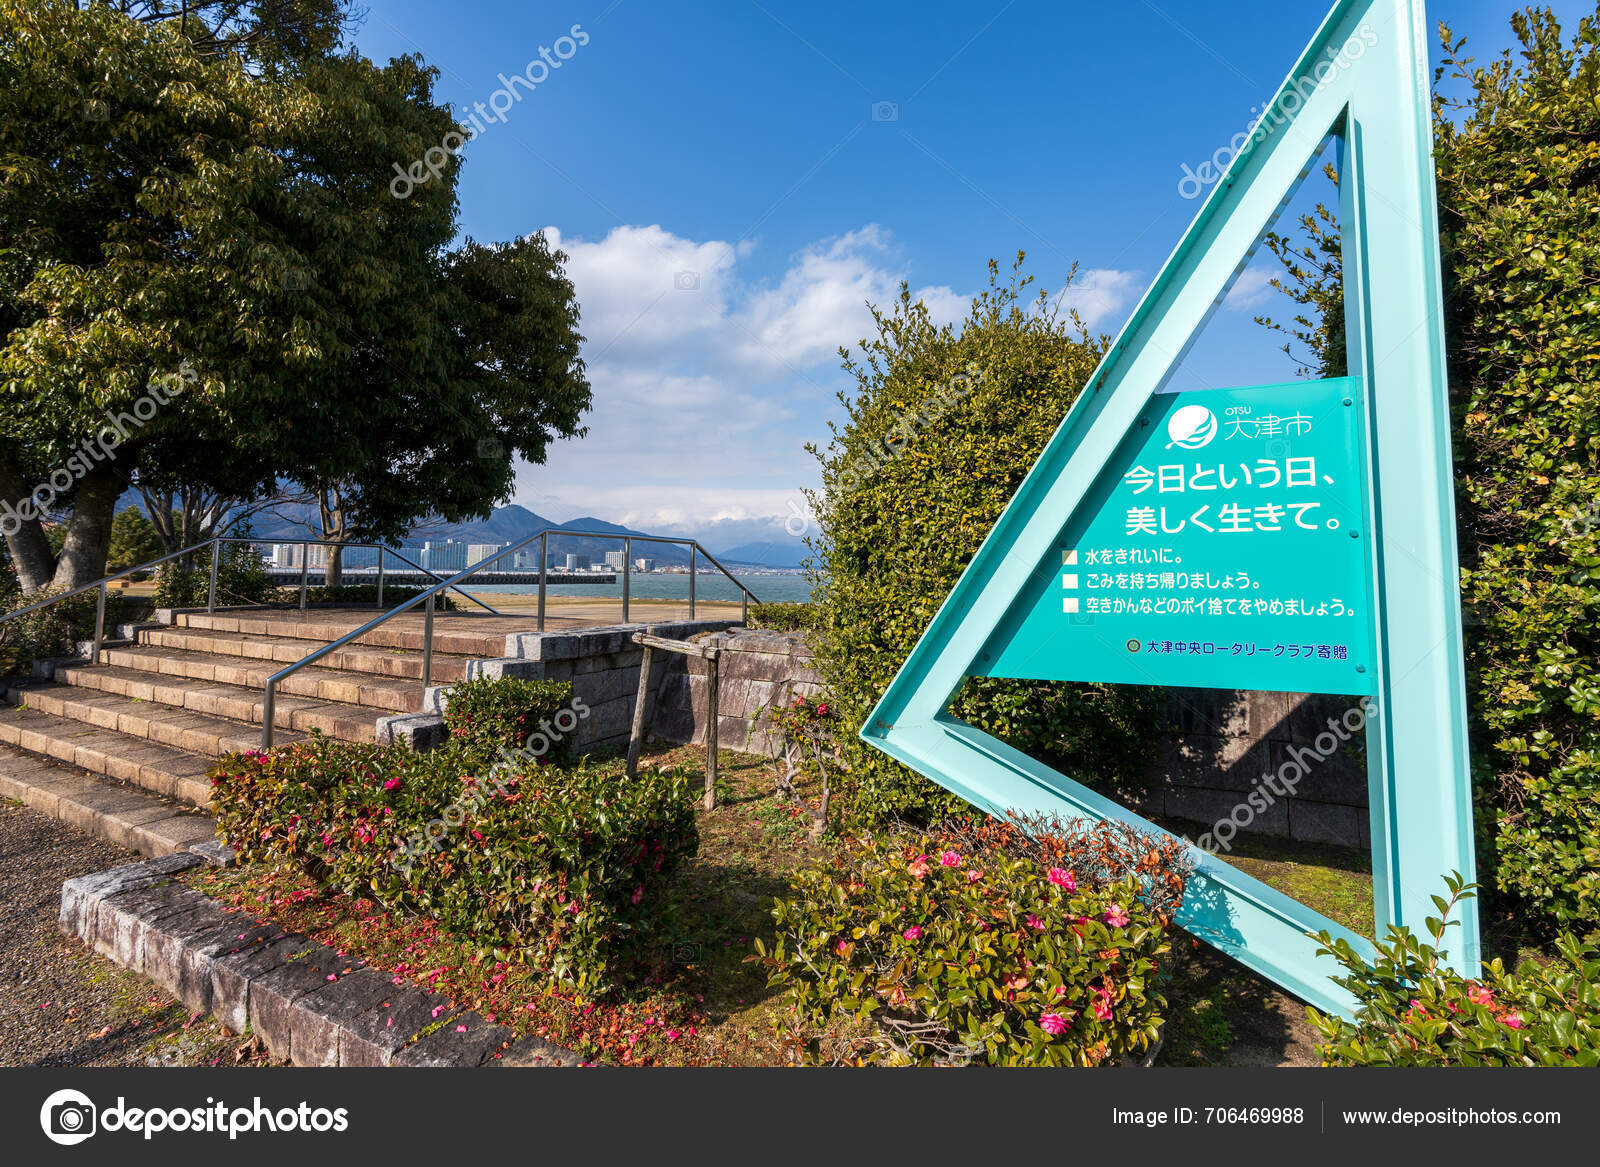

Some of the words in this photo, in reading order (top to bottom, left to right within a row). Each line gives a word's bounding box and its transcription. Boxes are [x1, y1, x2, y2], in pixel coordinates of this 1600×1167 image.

[1225, 407, 1252, 415] OTSU
[1224, 411, 1313, 440] 大津市
[1124, 457, 1335, 494] 今日という日、
[1125, 502, 1340, 536] 美しく生きて。
[1085, 548, 1182, 565] 水をきれいに。
[1086, 572, 1260, 590] ごみを持ち帰りましょう。
[1086, 597, 1355, 617] 空きかんなどのポイ捨てをやめましょう。
[1147, 640, 1347, 660] 大津中央ロータリークラブ寄贈
